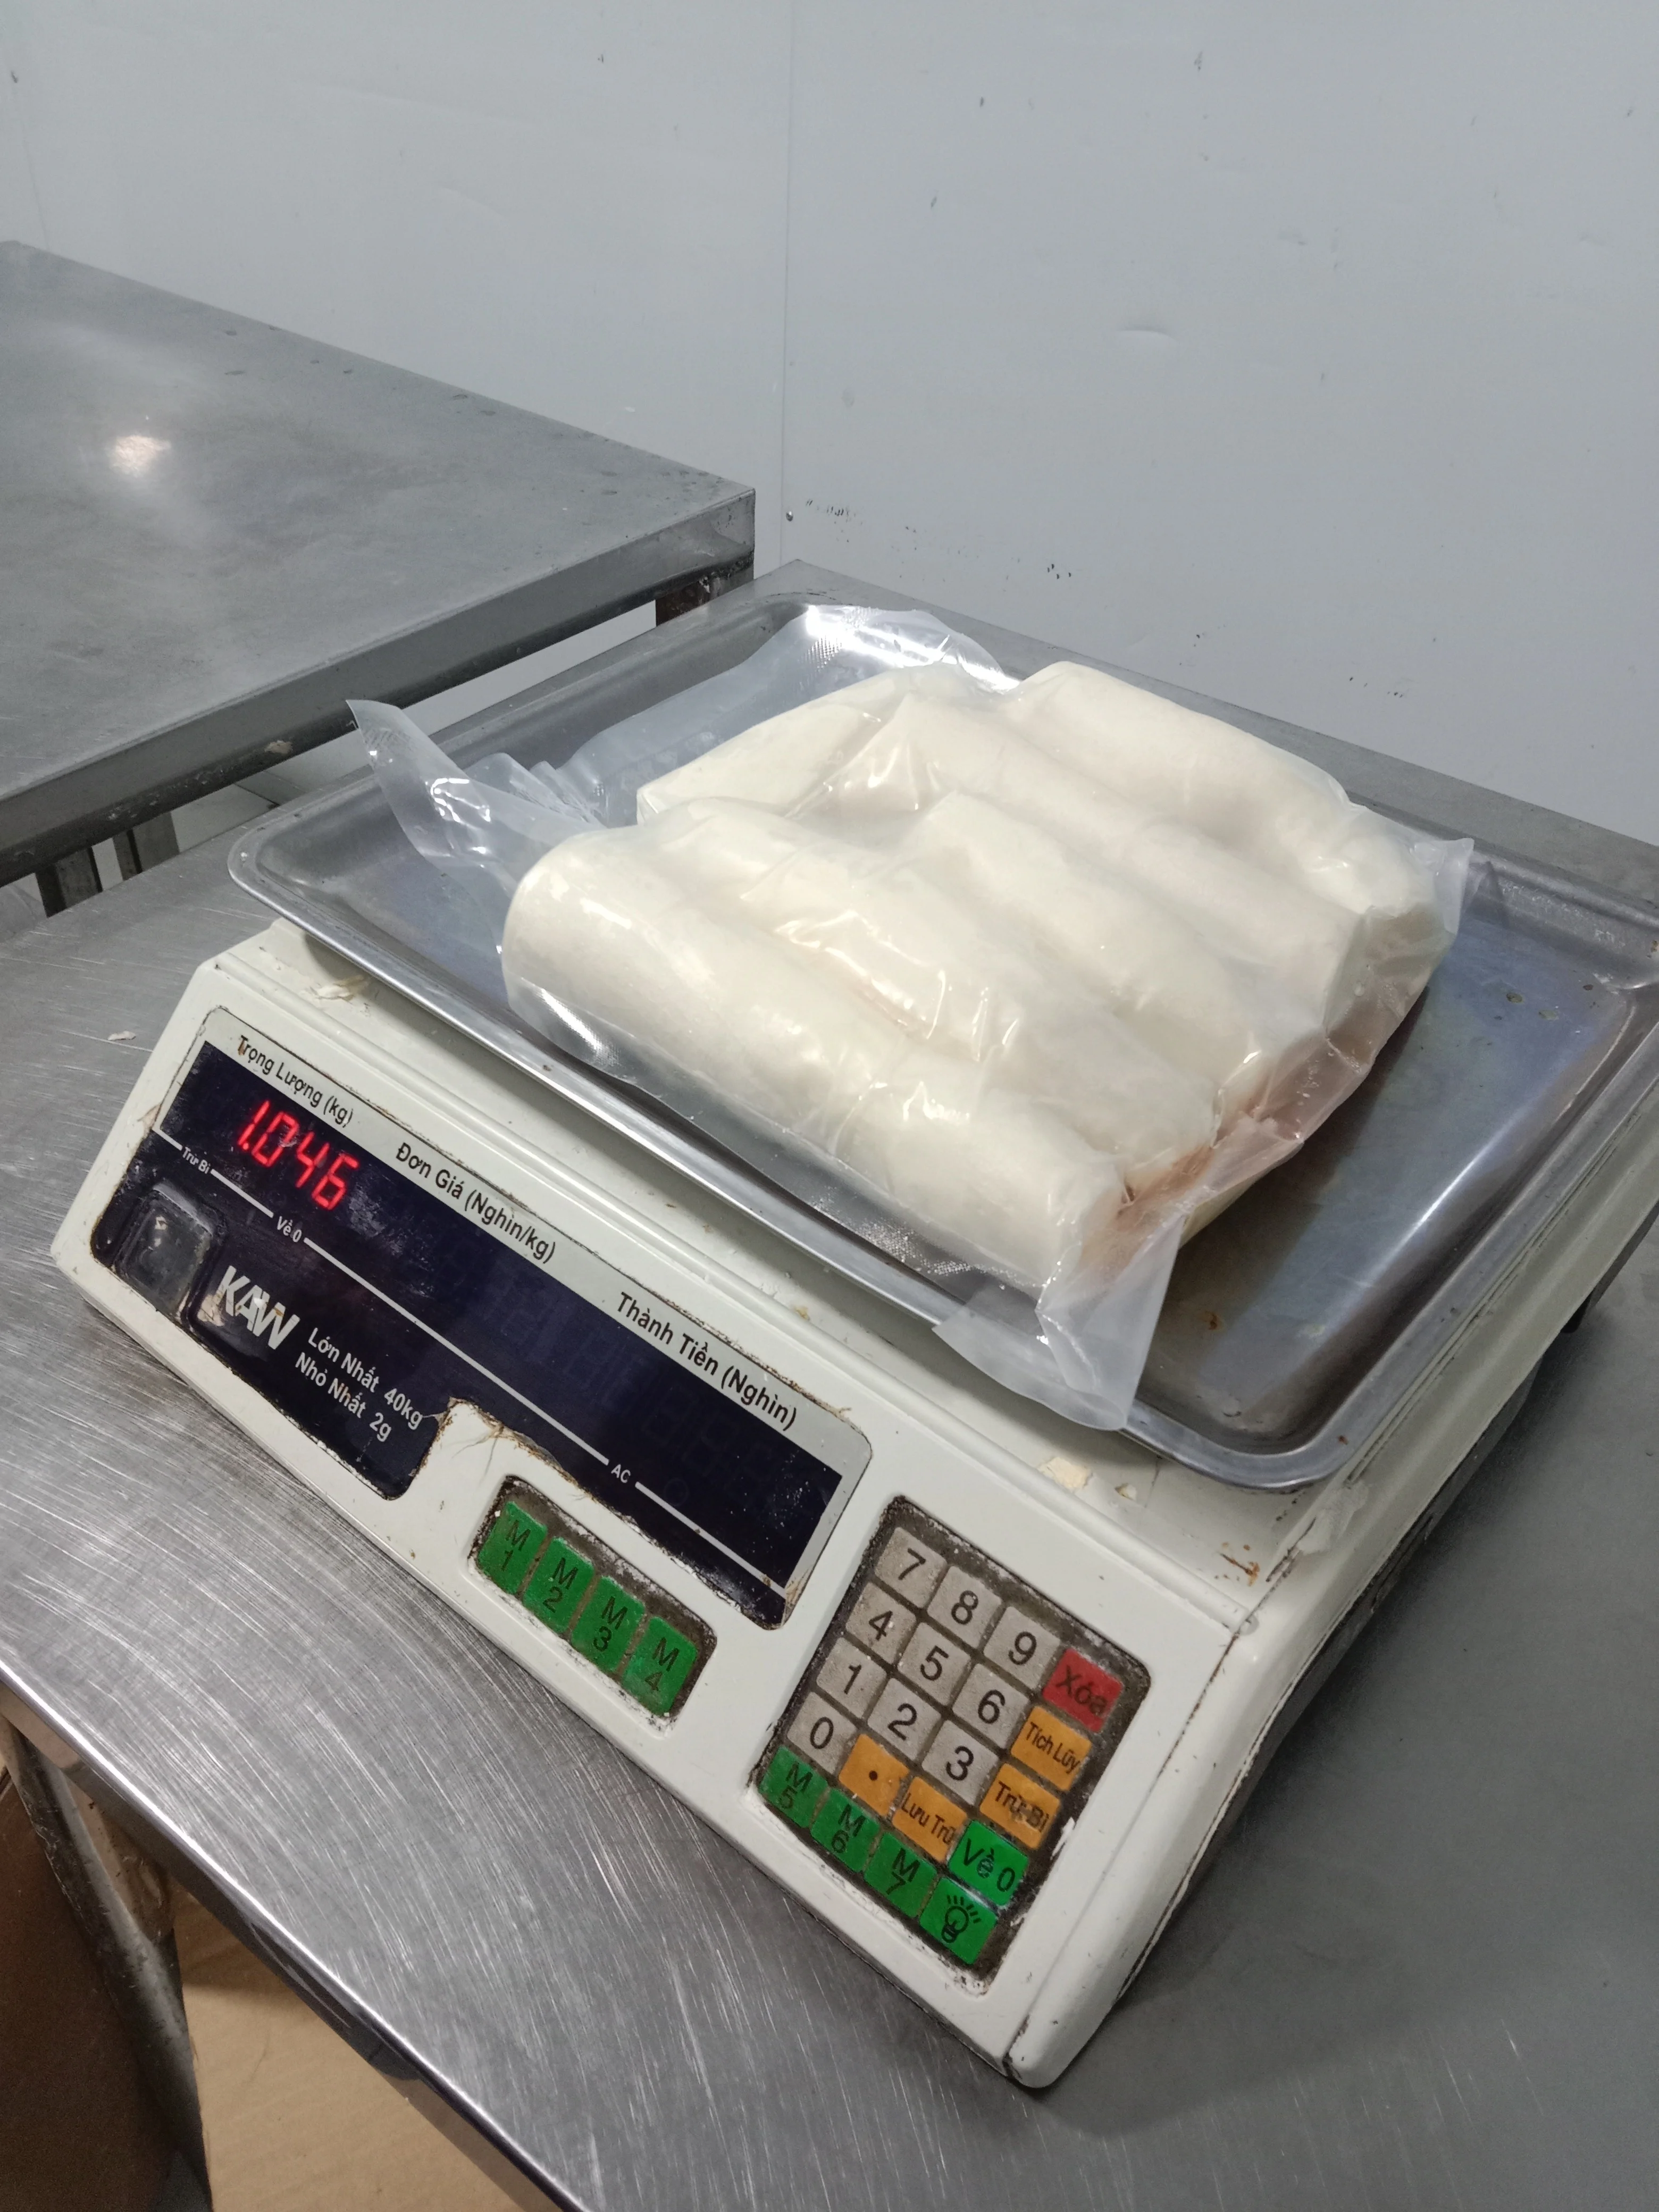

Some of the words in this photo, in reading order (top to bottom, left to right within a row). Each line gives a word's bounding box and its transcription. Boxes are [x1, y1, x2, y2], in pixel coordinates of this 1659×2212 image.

[238, 1035, 274, 1075] Trọng
[275, 1062, 323, 1108] Lượng
[323, 1095, 353, 1128] (kg)
[182, 1147, 199, 1165] Trừ
[237, 1100, 361, 1210] 1.046
[396, 1142, 431, 1178] Đơn
[435, 1169, 464, 1199] Giá
[465, 1189, 555, 1264] (Nghìn/kg)
[277, 1216, 293, 1236] Về
[292, 1230, 302, 1242] 0
[215, 1266, 300, 1350] KAW
[308, 1327, 340, 1362] Lớn
[341, 1353, 380, 1393] Nhất
[384, 1388, 423, 1430] 40kg
[617, 1292, 673, 1345] Thành
[678, 1333, 718, 1375] Tiền
[721, 1365, 797, 1431] (Nghìn)
[295, 1352, 328, 1387] Nhỏ
[328, 1378, 367, 1418] Nhất
[370, 1412, 392, 1442] 2g
[610, 1464, 631, 1483] AC
[506, 1519, 532, 1552] M
[501, 1550, 514, 1571] 1
[551, 1557, 579, 1590] M
[898, 1548, 926, 1580] 7
[542, 1586, 563, 1613] 2
[601, 1596, 628, 1630] M
[951, 1590, 978, 1625] 8
[593, 1626, 613, 1652] 3
[868, 1610, 893, 1641] 4
[652, 1637, 679, 1672] M
[920, 1645, 949, 1681] 5
[1008, 1631, 1037, 1665] 9
[644, 1671, 663, 1692] 4
[844, 1664, 861, 1695] 1
[1055, 1664, 1108, 1716] Xóa
[887, 1703, 917, 1740] 2
[977, 1690, 1006, 1724] 6
[809, 1716, 834, 1749] 0
[1026, 1722, 1054, 1755] Tích
[1053, 1743, 1080, 1774] Lũy
[785, 1763, 814, 1792] M
[945, 1746, 974, 1781] 3
[780, 1785, 796, 1809] 5
[901, 1792, 930, 1828] Lưu
[838, 1804, 866, 1837] M
[831, 1829, 849, 1854] 6
[892, 1848, 920, 1882] M
[962, 1838, 995, 1879] Về
[996, 1867, 1016, 1892] 0
[886, 1872, 906, 1895] 7
